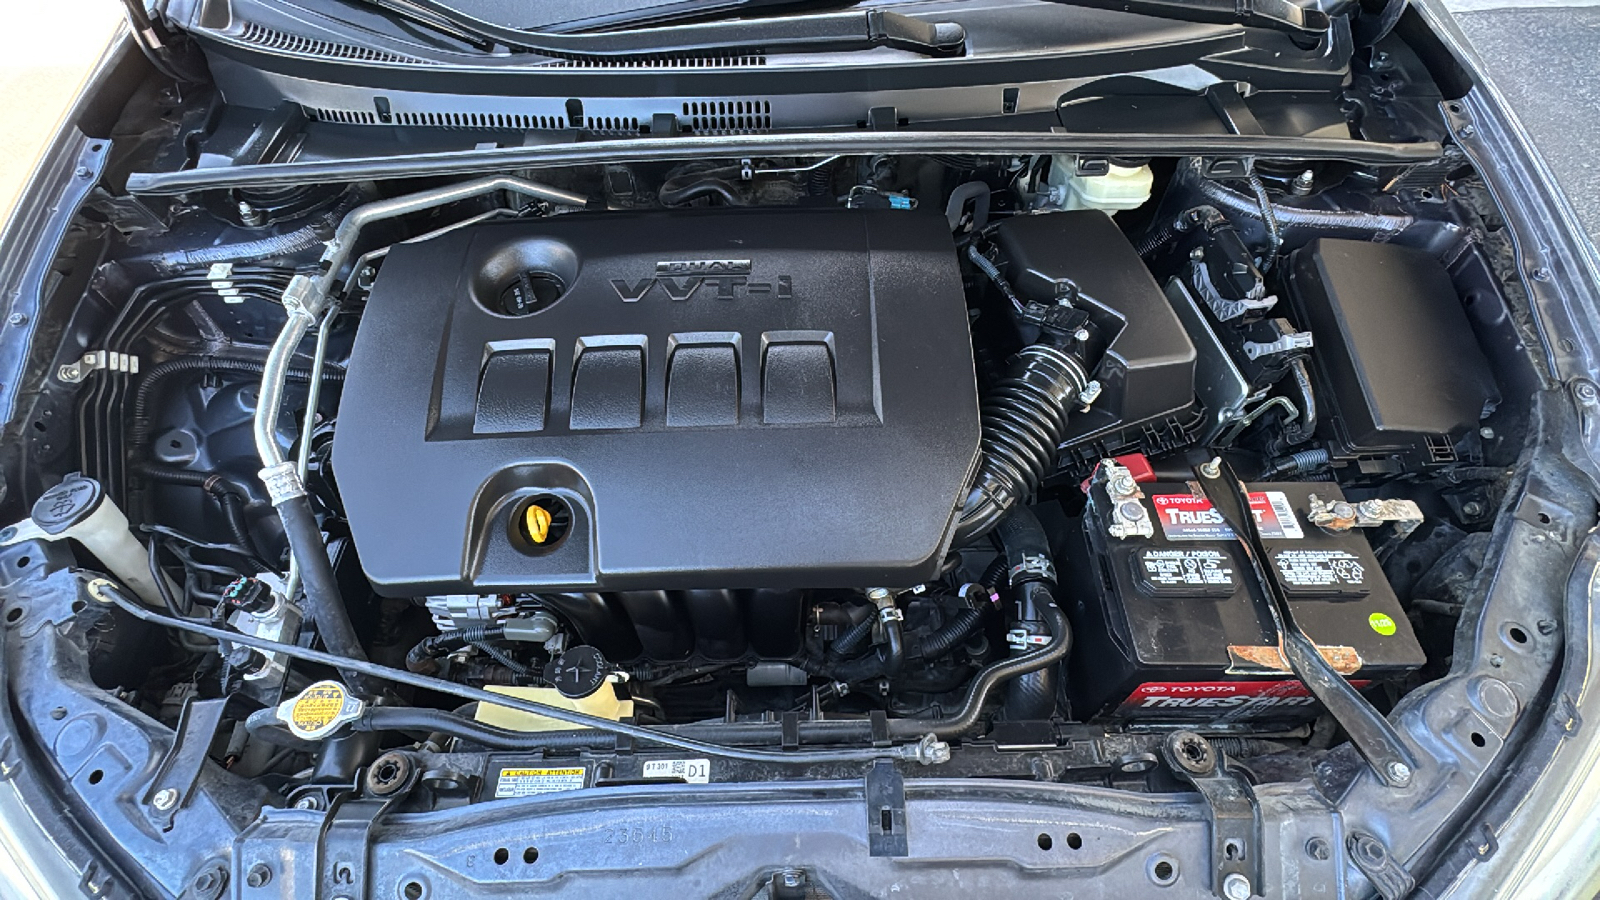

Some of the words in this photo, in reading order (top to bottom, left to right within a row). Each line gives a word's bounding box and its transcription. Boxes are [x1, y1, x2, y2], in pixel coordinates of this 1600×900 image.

[1168, 497, 1204, 505] TOYOTA
[589, 652, 604, 687] COOLANT
[688, 764, 707, 778] D1
